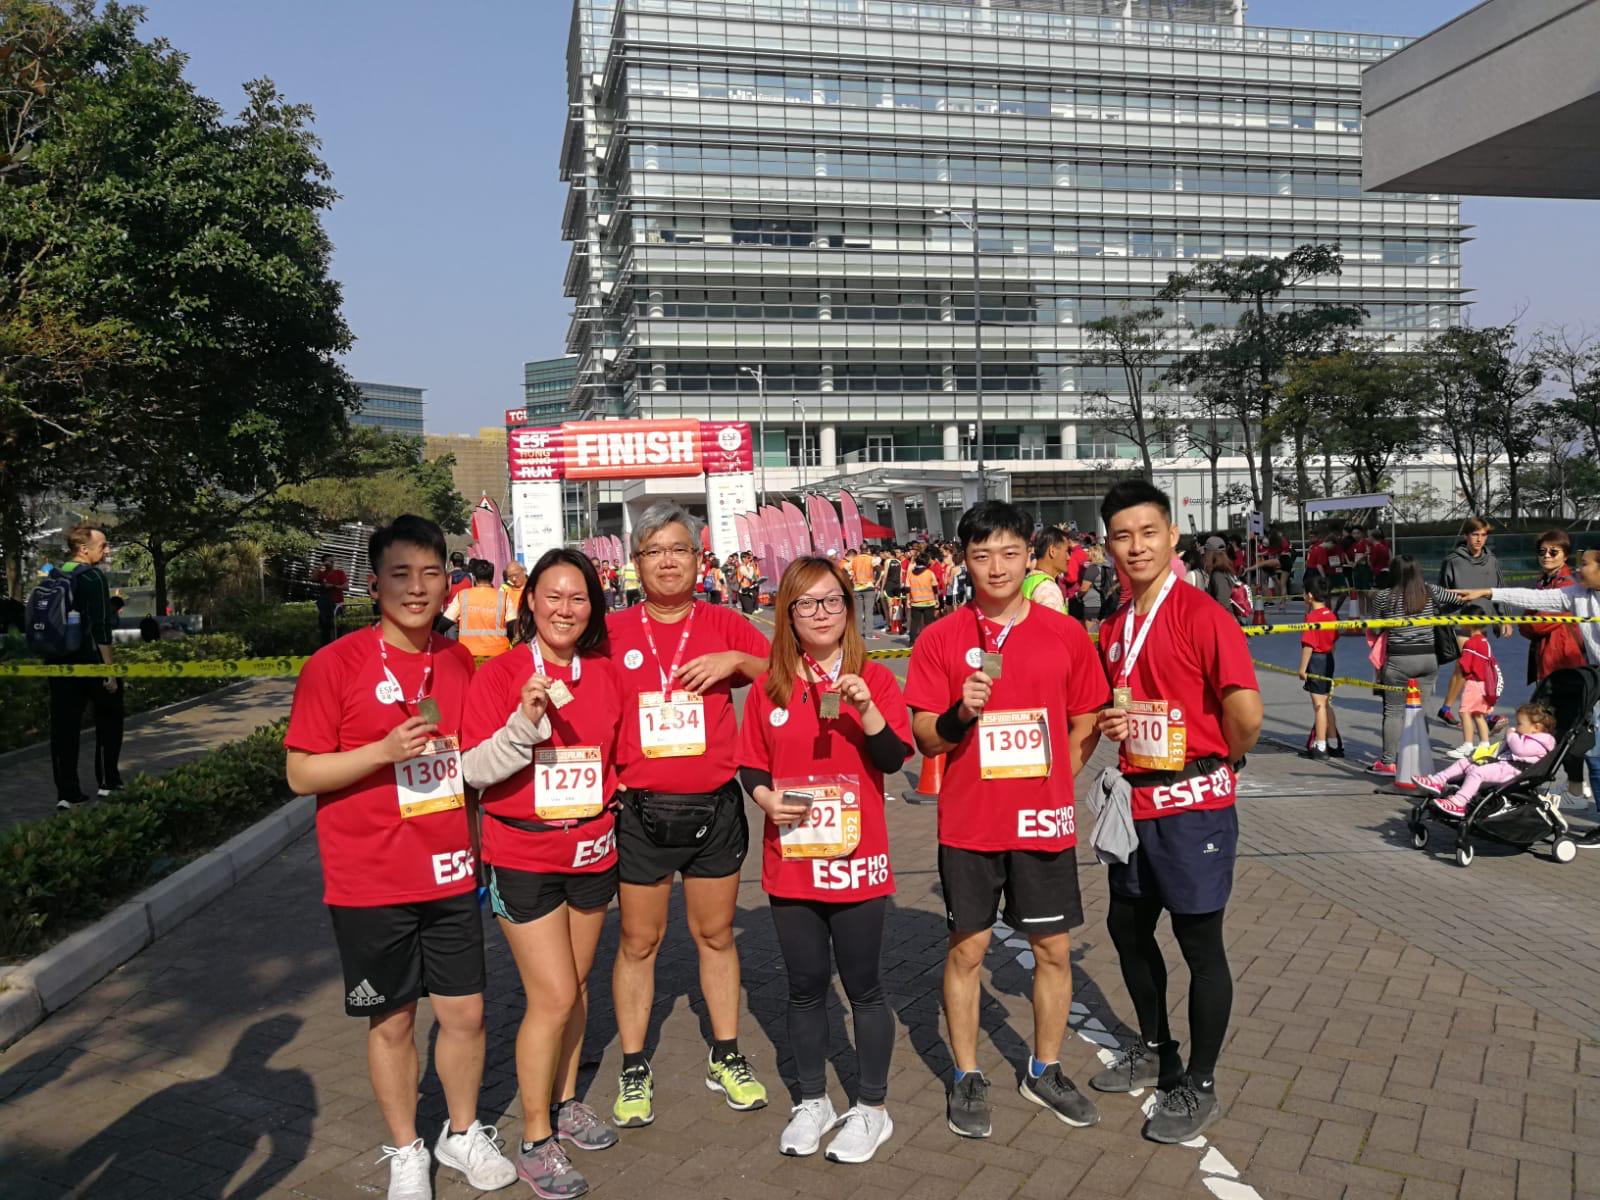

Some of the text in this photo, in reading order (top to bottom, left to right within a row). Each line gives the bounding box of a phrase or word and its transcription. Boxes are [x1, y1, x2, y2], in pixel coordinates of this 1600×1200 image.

[519, 432, 550, 448] ESF
[576, 430, 695, 467] FINISH
[519, 466, 553, 478] RUN
[986, 728, 1042, 752] 1309
[1172, 732, 1183, 763] 1310
[402, 756, 458, 787] 1308
[541, 767, 597, 791] 1279
[1153, 775, 1211, 810] ESF
[1018, 808, 1061, 839] ESF
[812, 853, 888, 890] ESF HO
[868, 868, 888, 887] KO
